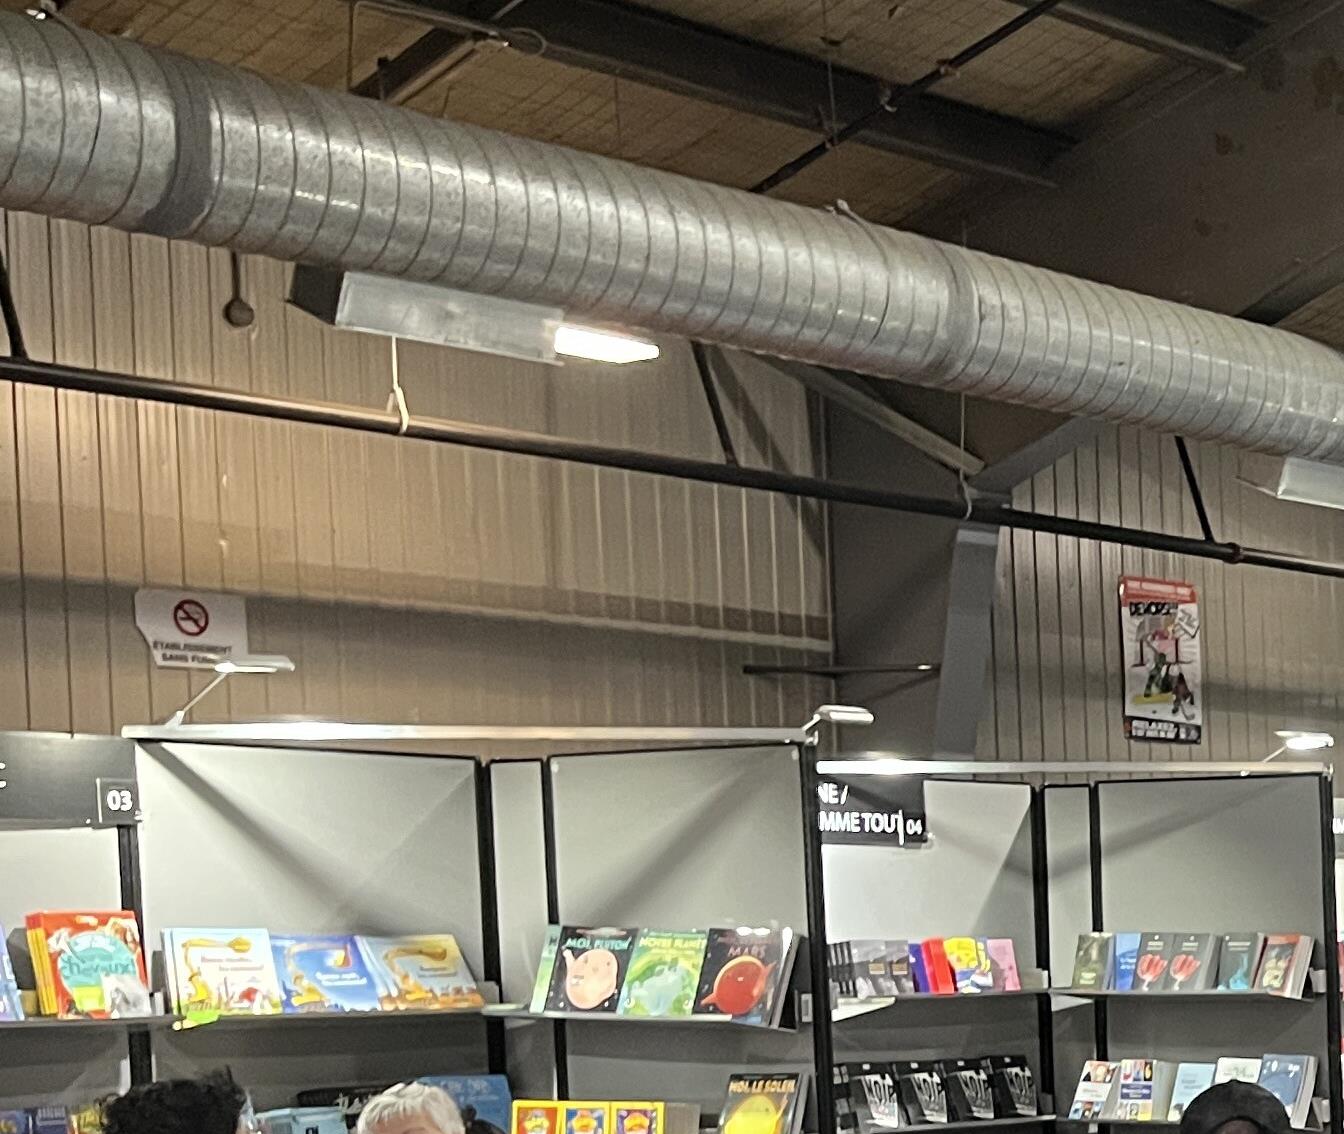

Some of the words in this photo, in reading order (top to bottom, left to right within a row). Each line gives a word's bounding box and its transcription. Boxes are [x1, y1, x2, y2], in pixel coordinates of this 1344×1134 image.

[106, 789, 133, 811] 03
[861, 812, 902, 833] TOUT
[906, 819, 922, 835] 04
